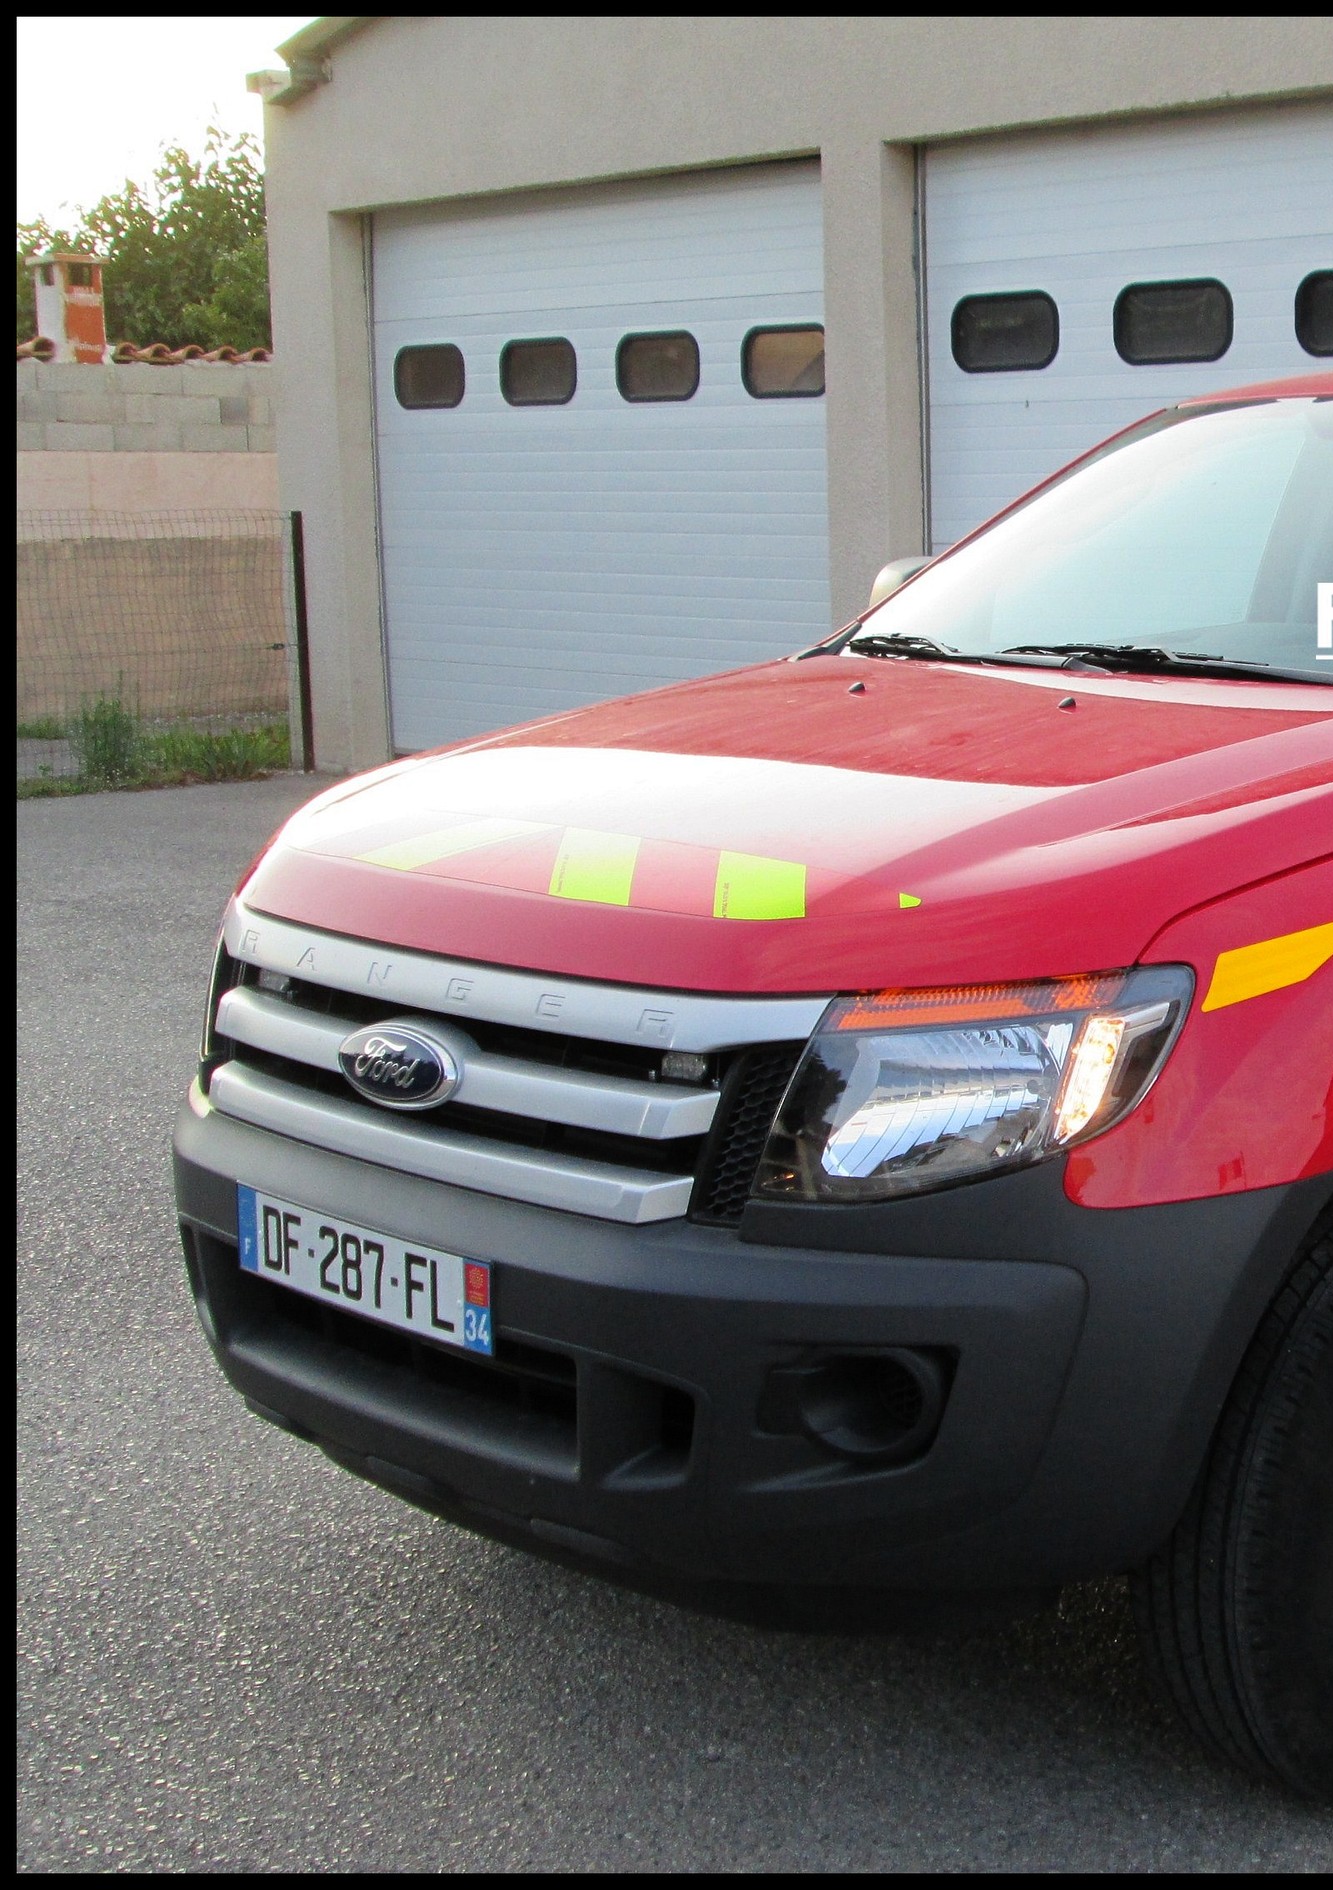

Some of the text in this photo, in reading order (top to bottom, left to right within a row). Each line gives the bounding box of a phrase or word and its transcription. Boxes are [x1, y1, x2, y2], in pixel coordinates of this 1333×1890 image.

[240, 928, 674, 1042] RANGER
[355, 1037, 421, 1089] Ford
[465, 1309, 489, 1346] 34
